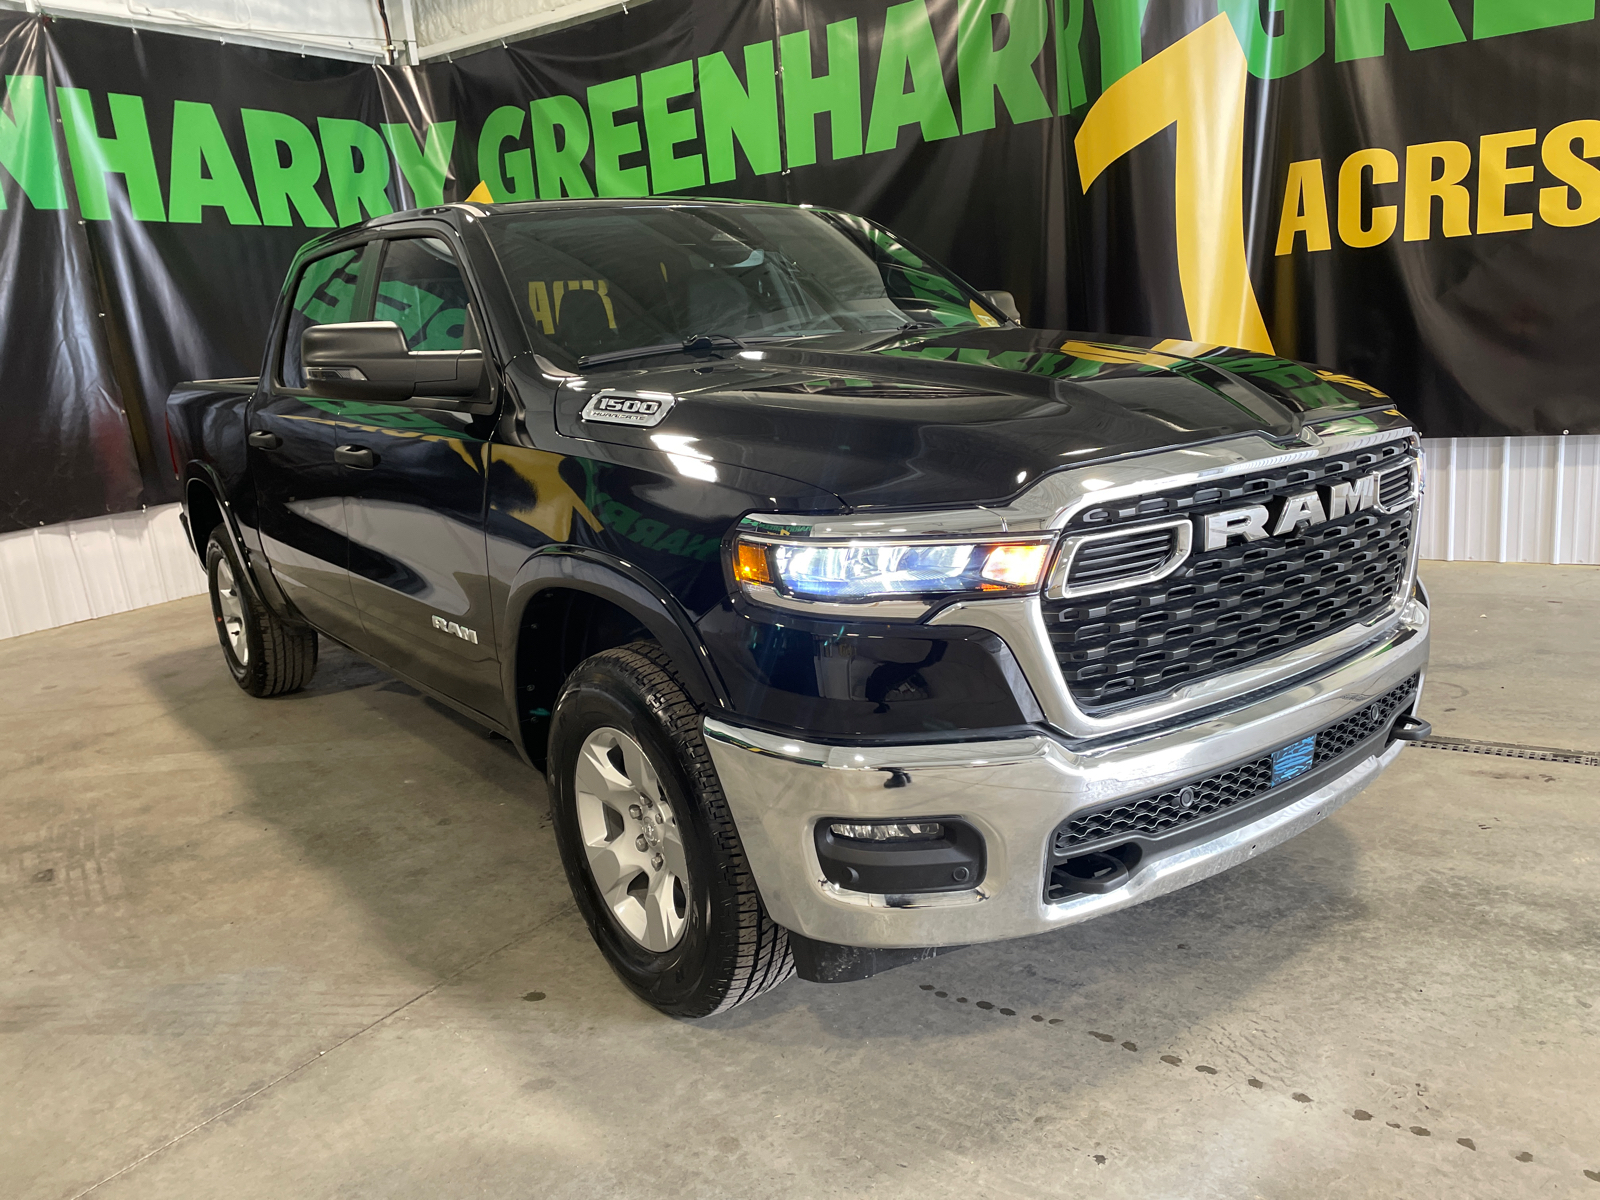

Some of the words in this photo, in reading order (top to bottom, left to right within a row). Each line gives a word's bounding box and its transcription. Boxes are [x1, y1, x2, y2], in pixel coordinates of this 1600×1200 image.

[56, 86, 456, 229] HARRY
[1074, 11, 1275, 356] 7
[1275, 119, 1600, 256] ACRES
[599, 398, 660, 415] 1500
[1204, 474, 1375, 552] RAM
[431, 614, 479, 645] RAM
